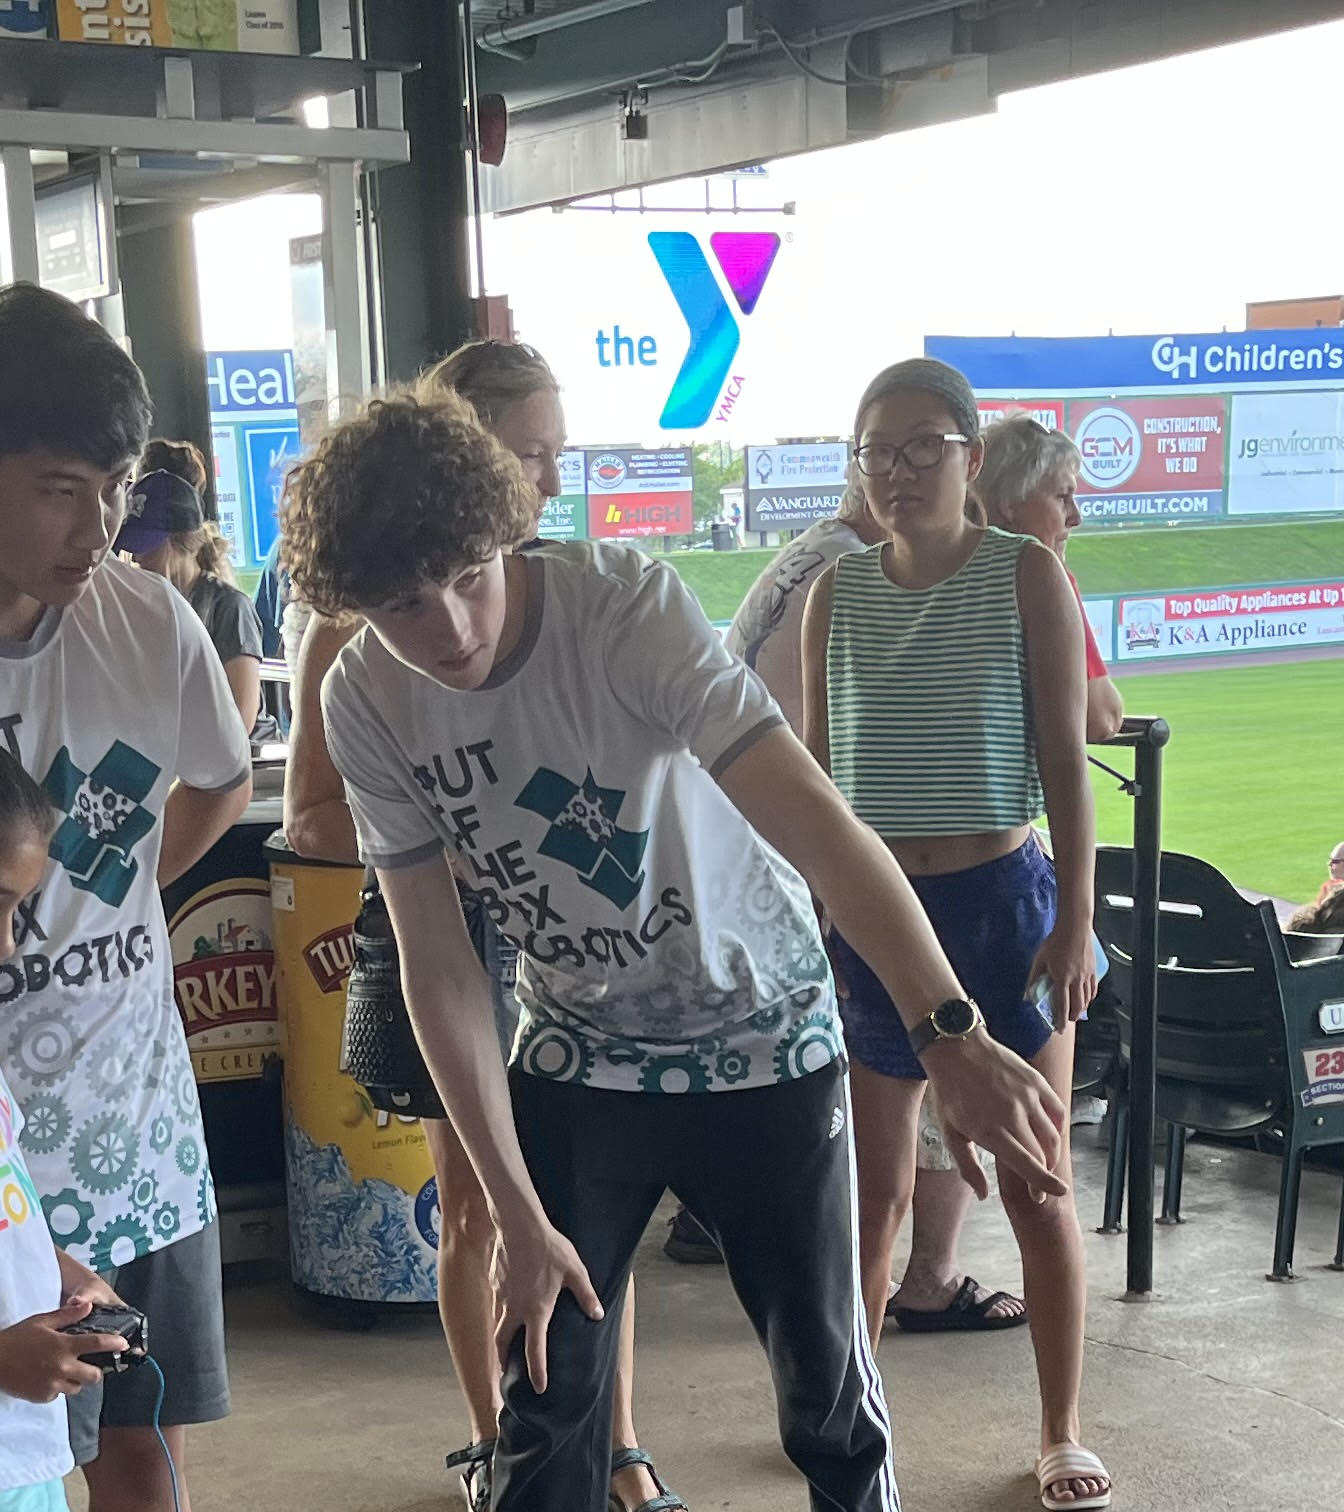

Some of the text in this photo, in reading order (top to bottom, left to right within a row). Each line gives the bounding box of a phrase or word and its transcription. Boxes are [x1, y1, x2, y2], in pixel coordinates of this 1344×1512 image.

[596, 325, 657, 368] the
[1204, 342, 1343, 374] Children's
[716, 375, 745, 422] YMCA
[1144, 416, 1222, 435] CONSTRUCTION,
[1081, 436, 1133, 458] GCM
[1157, 436, 1207, 454] IT'S WHAT
[781, 464, 838, 475] Fire Protection
[1092, 458, 1122, 470] BUILT
[1166, 456, 1198, 473] WE DO
[772, 495, 842, 511] VANGUARD
[1080, 496, 1208, 517] GCMBUILT.COM
[624, 505, 681, 523] HIGH
[1169, 599, 1192, 617] Top
[1194, 594, 1238, 614] Quality
[1240, 590, 1306, 612] Appliances
[1308, 589, 1322, 605] At
[1322, 588, 1339, 606] Up
[1168, 619, 1307, 646] K&A Appliance
[1330, 1007, 1342, 1026] U
[372, 1137, 403, 1150] Lemon
